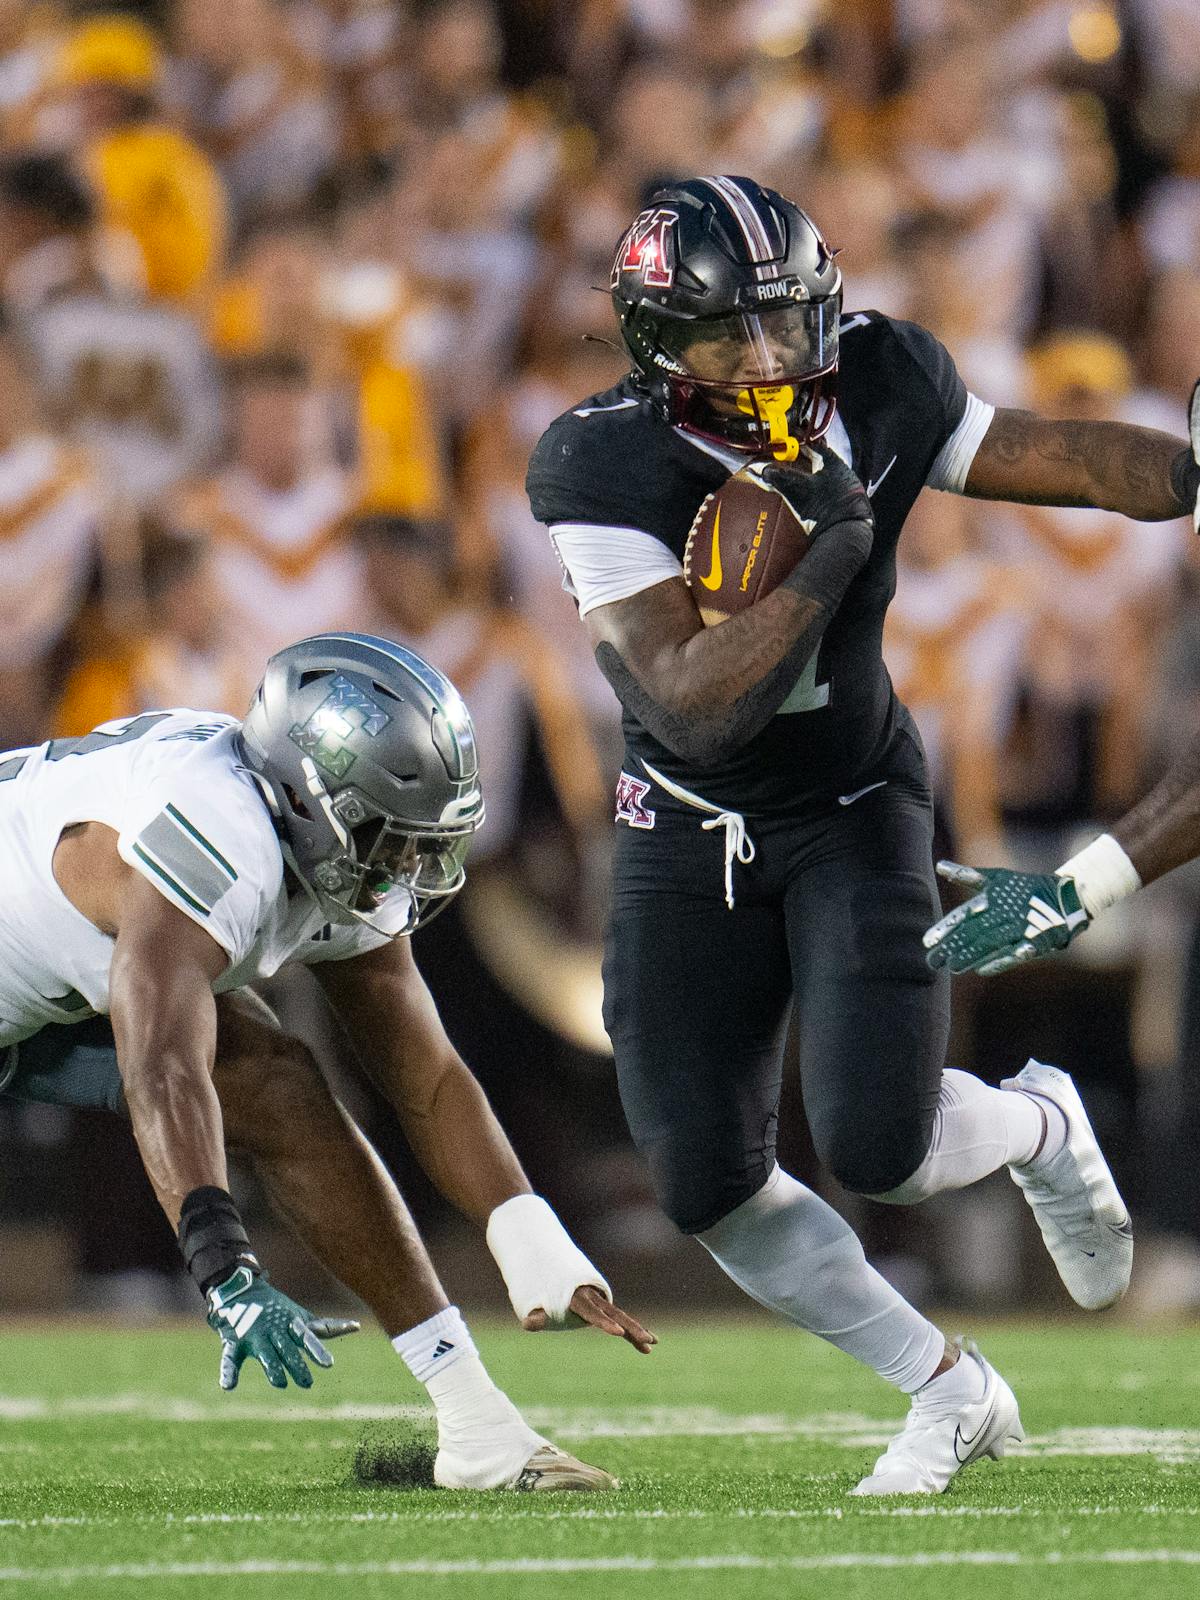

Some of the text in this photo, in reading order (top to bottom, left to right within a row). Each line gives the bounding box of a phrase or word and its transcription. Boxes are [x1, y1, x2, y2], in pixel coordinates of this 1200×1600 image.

[610, 208, 680, 288] M
[757, 281, 788, 301] ROW
[739, 511, 768, 593] VAPOR ELITE
[614, 770, 656, 830] M
